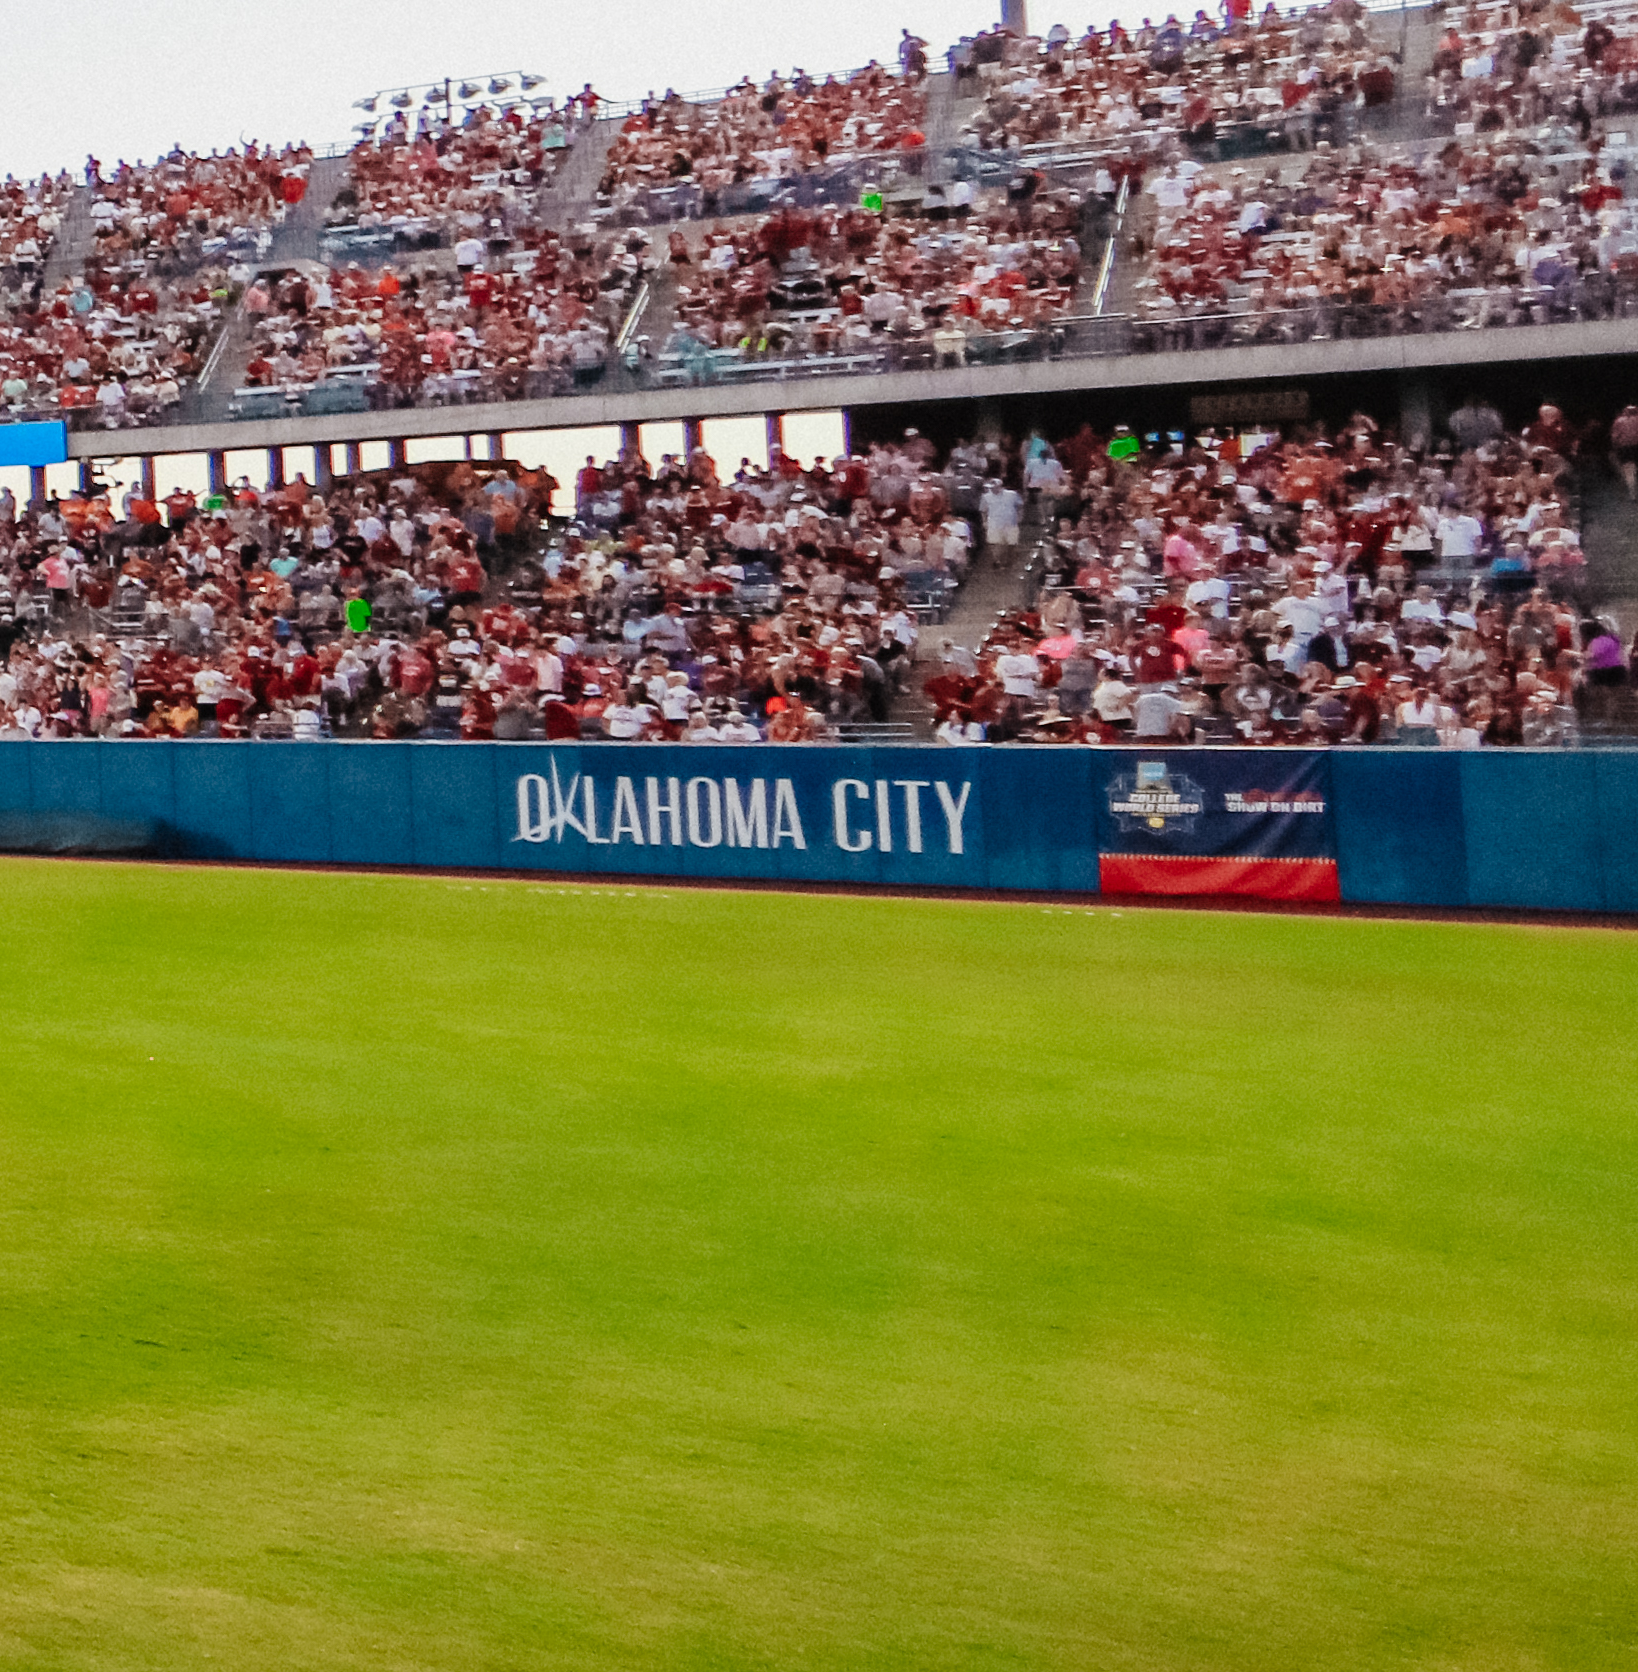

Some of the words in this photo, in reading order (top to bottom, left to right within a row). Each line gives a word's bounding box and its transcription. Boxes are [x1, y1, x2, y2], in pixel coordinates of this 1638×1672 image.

[511, 752, 807, 851] OKLAHOMA
[831, 778, 972, 854] CITY
[1227, 802, 1268, 813] SHOW
[1270, 802, 1289, 813] ON
[1292, 801, 1326, 813] DIRT
